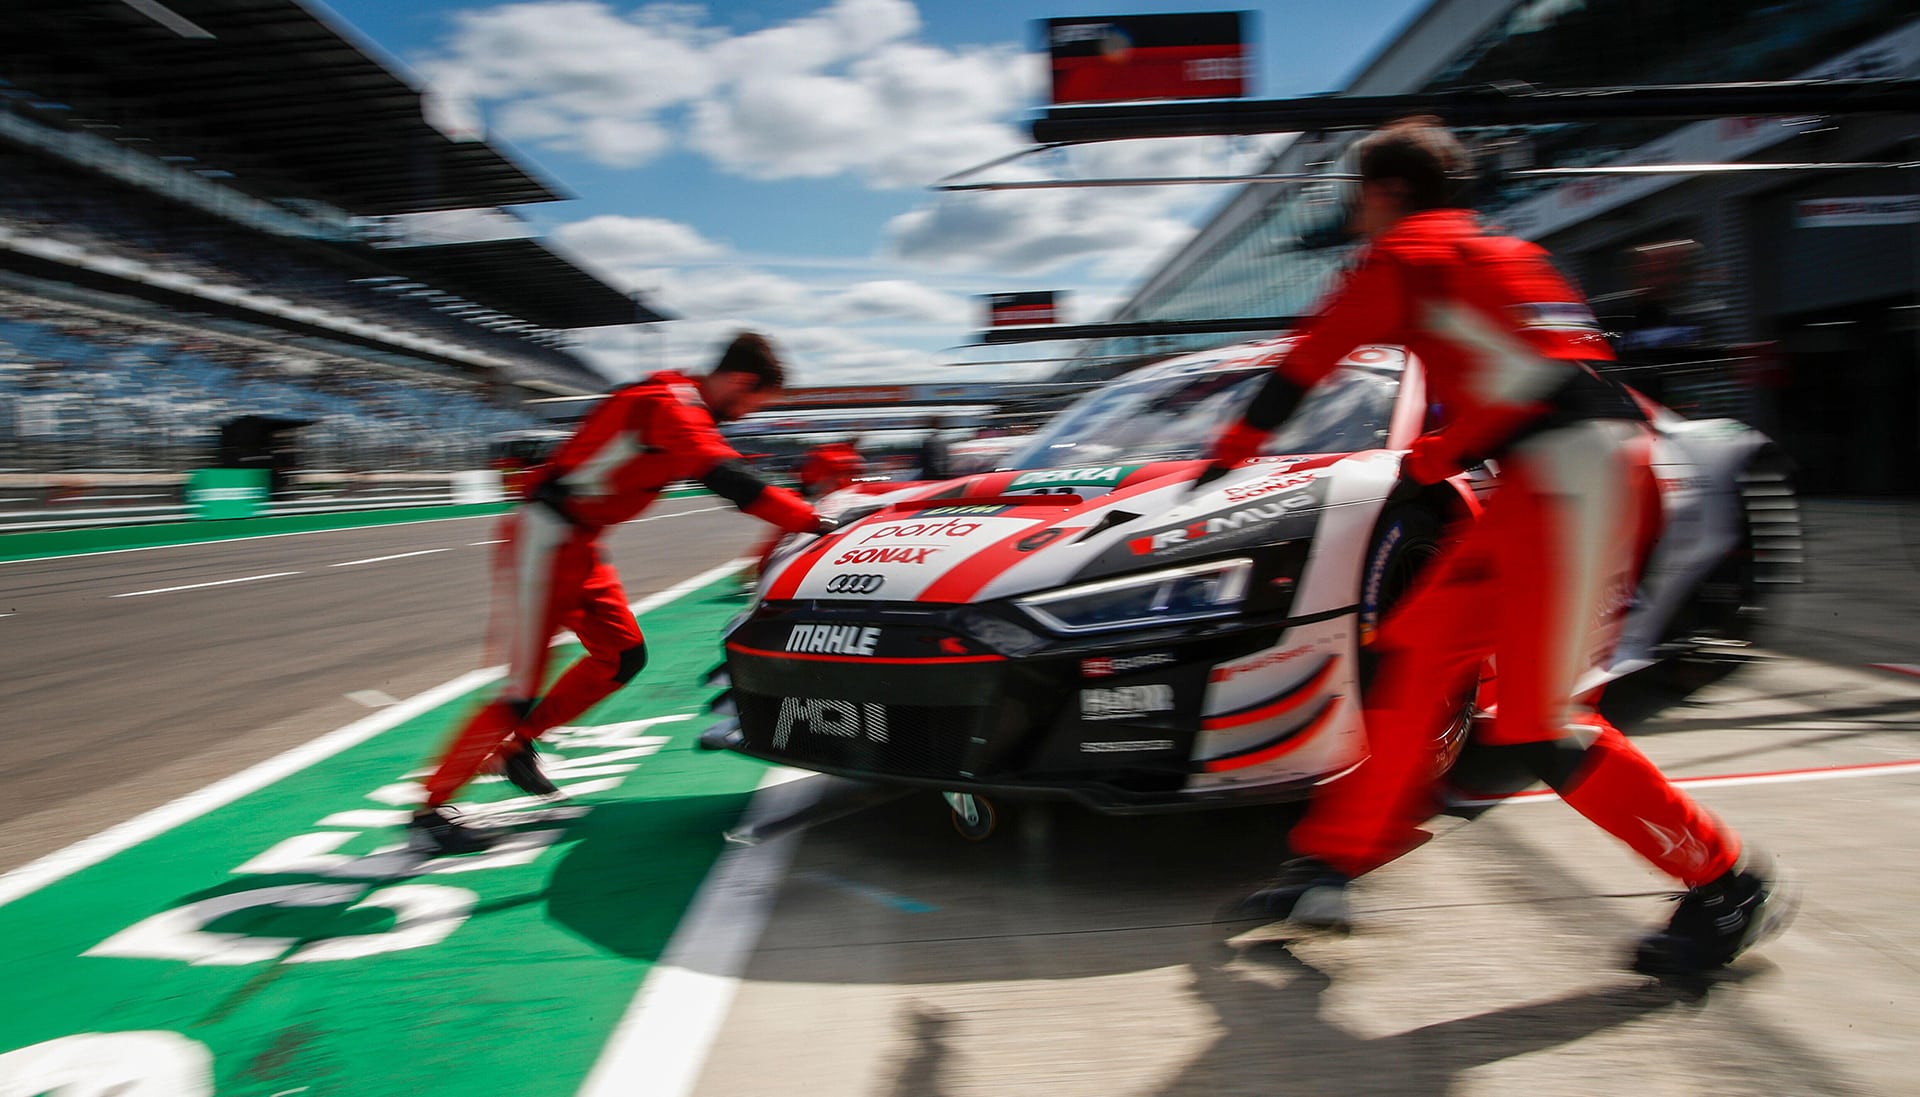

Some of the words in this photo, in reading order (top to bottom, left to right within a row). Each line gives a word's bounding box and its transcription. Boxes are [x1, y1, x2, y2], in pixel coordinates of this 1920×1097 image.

[1011, 466, 1123, 486] DEKRA
[859, 518, 983, 545] porta
[1152, 494, 1317, 549] REMUS
[834, 547, 941, 566] SONAX
[785, 624, 882, 656] MAHLE
